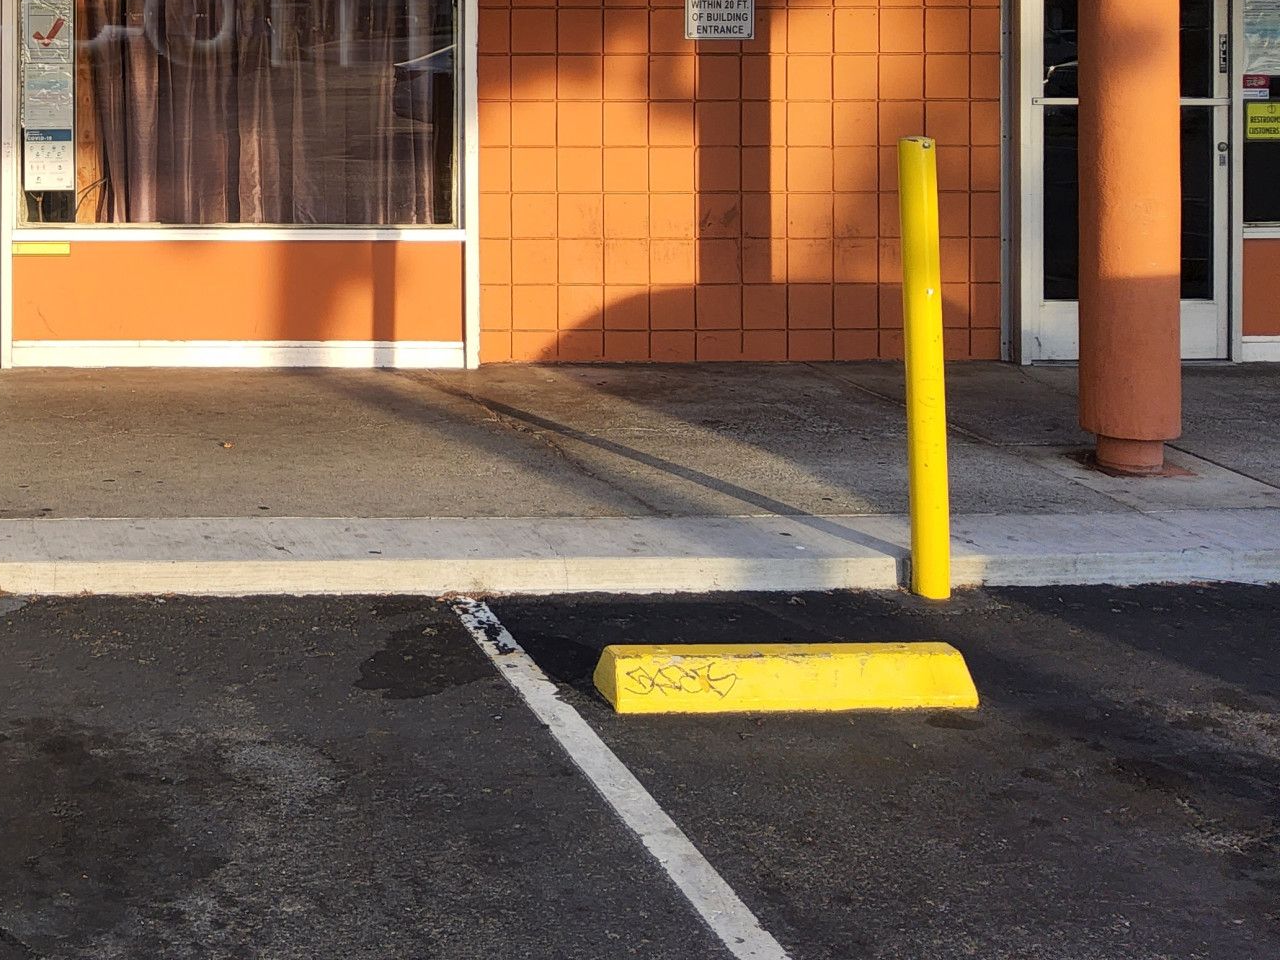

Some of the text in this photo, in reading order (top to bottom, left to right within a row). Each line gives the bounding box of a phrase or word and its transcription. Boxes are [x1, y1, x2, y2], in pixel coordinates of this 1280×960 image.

[691, 0, 750, 10] WITHIN 20 FT.
[692, 13, 749, 22] OF BUILDING
[696, 25, 745, 35] ENTRANCE
